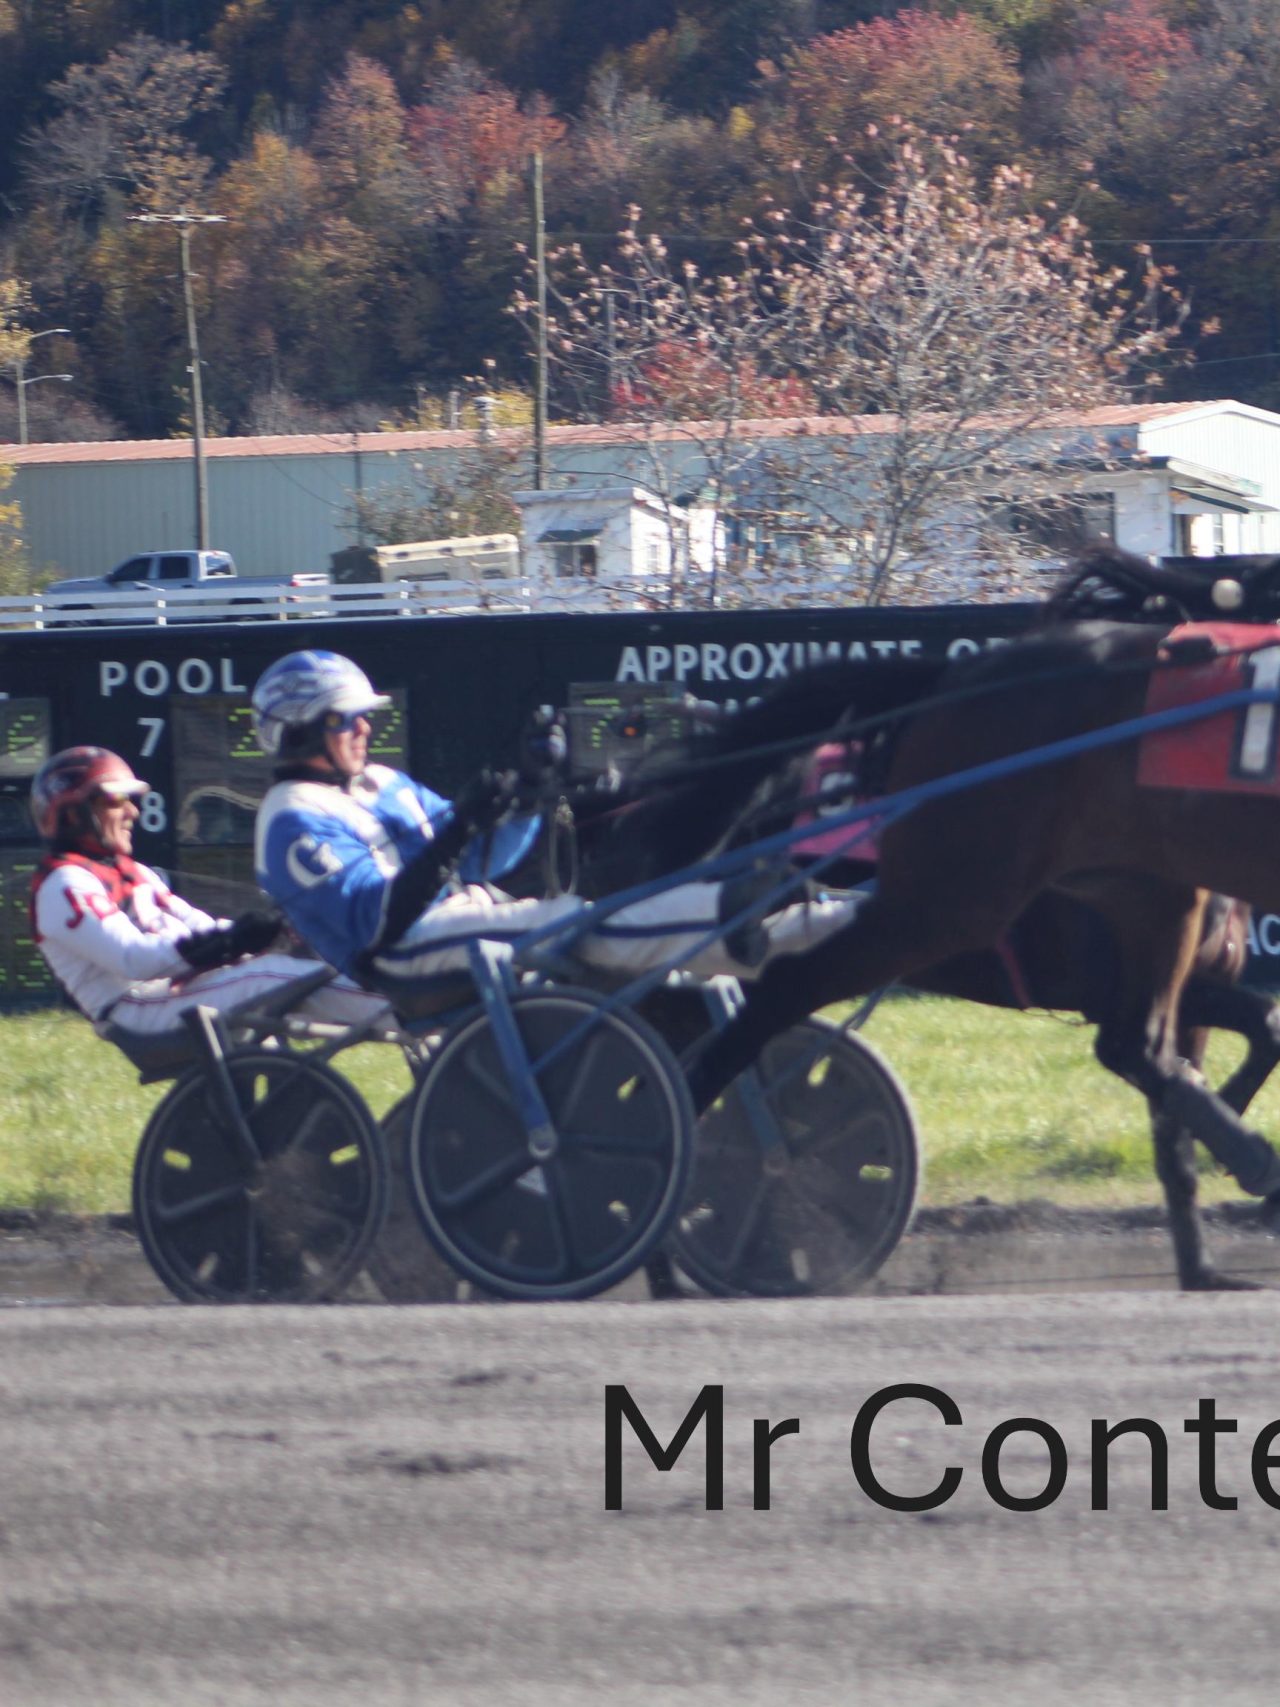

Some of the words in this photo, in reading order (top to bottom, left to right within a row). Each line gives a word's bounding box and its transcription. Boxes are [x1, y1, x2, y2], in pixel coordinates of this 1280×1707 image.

[99, 658, 248, 697] POOL
[137, 717, 165, 757] 7
[139, 791, 168, 832] 8
